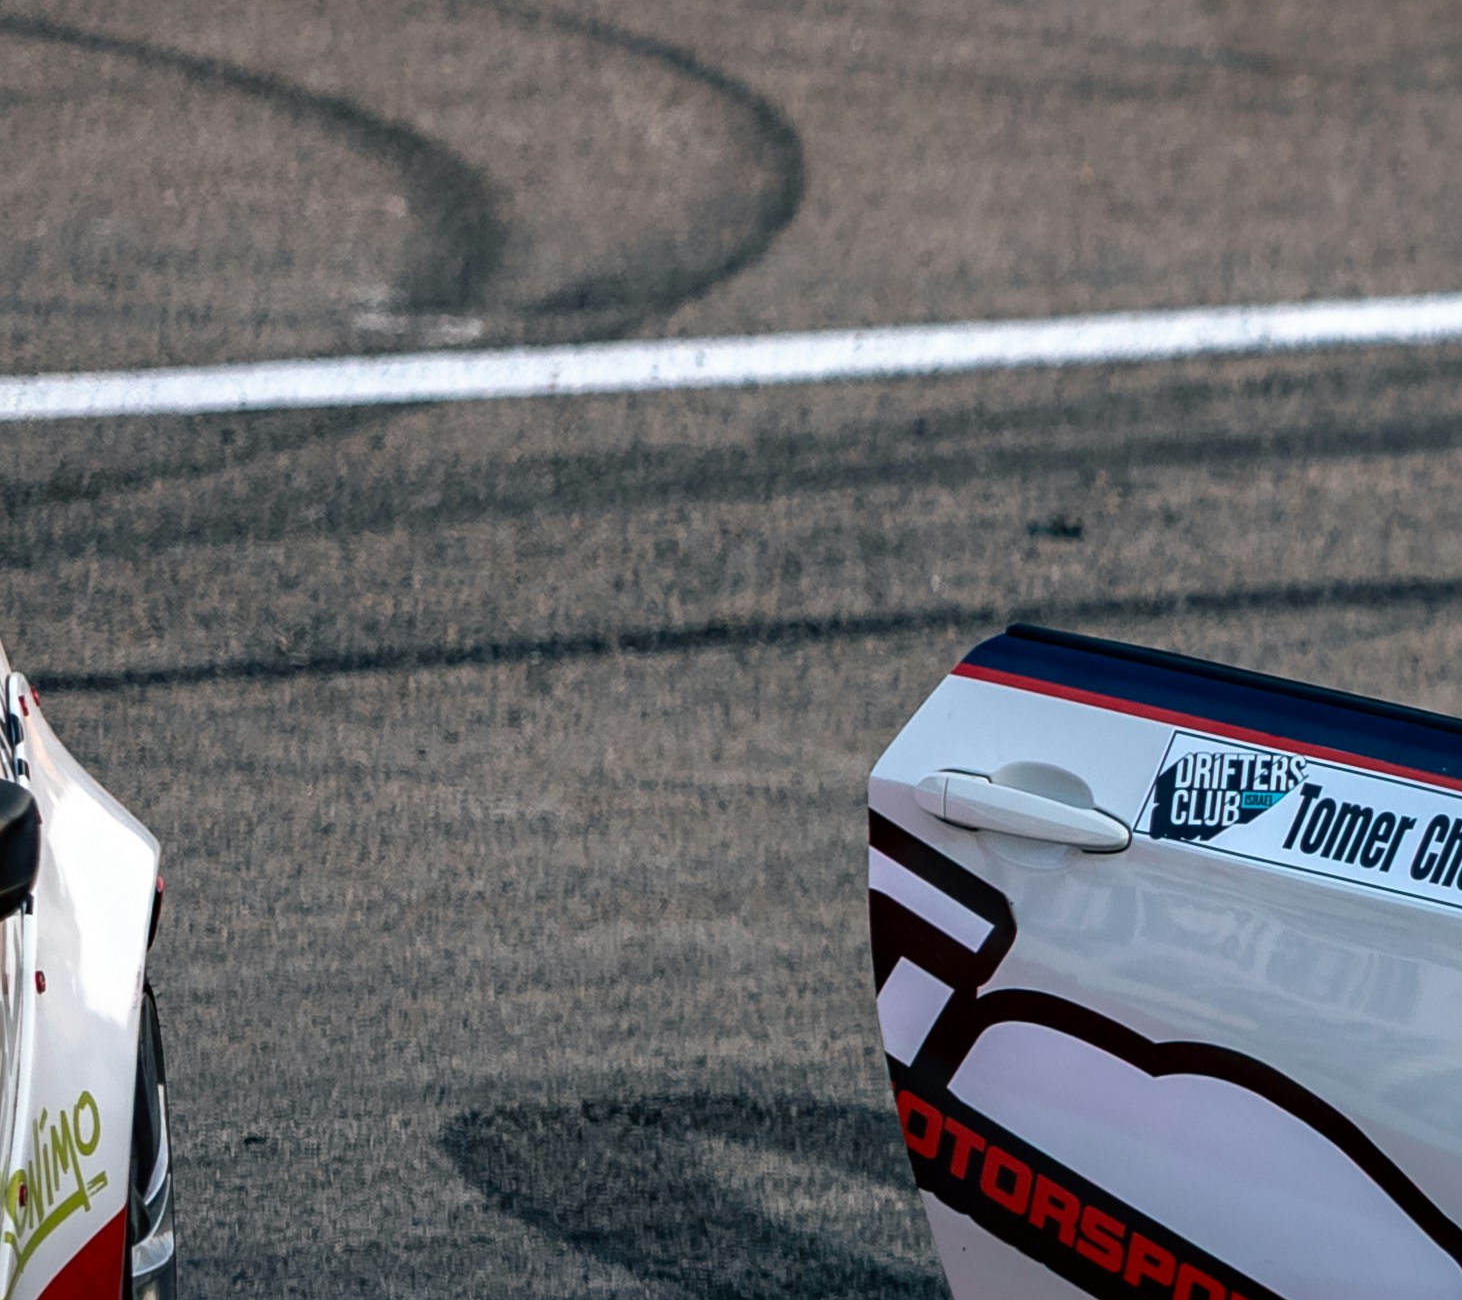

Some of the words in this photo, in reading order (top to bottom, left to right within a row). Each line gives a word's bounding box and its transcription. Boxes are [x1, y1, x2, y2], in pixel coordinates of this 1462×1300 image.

[1175, 753, 1307, 792] DRIFTERS
[1170, 789, 1241, 827] CLUB
[1282, 782, 1416, 873] Tomer
